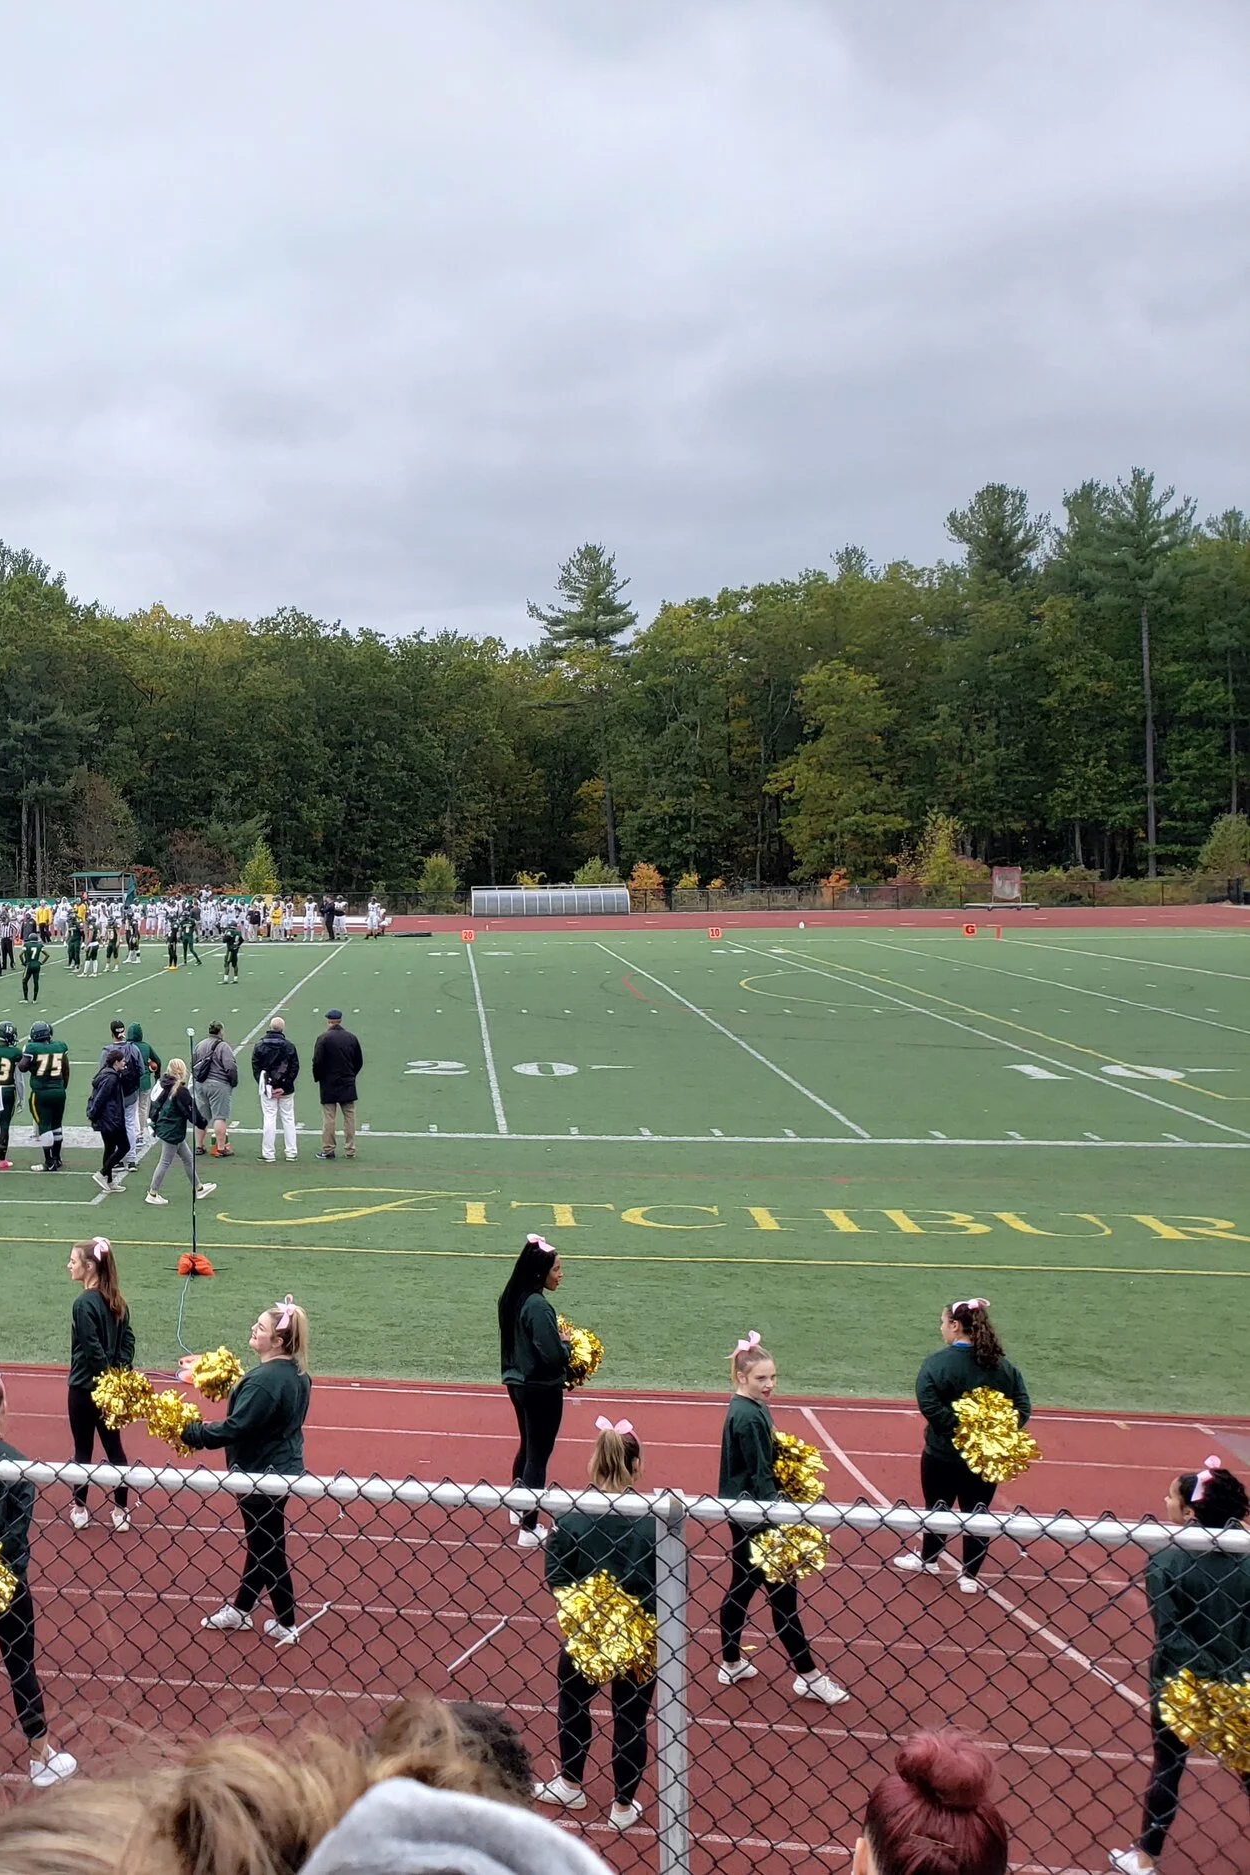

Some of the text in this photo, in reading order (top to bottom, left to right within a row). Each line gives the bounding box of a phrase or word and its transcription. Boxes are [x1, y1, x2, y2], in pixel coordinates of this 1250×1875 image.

[710, 928, 720, 937] 10
[965, 925, 975, 934] G
[30, 947, 37, 960] 7
[36, 1053, 62, 1077] 75
